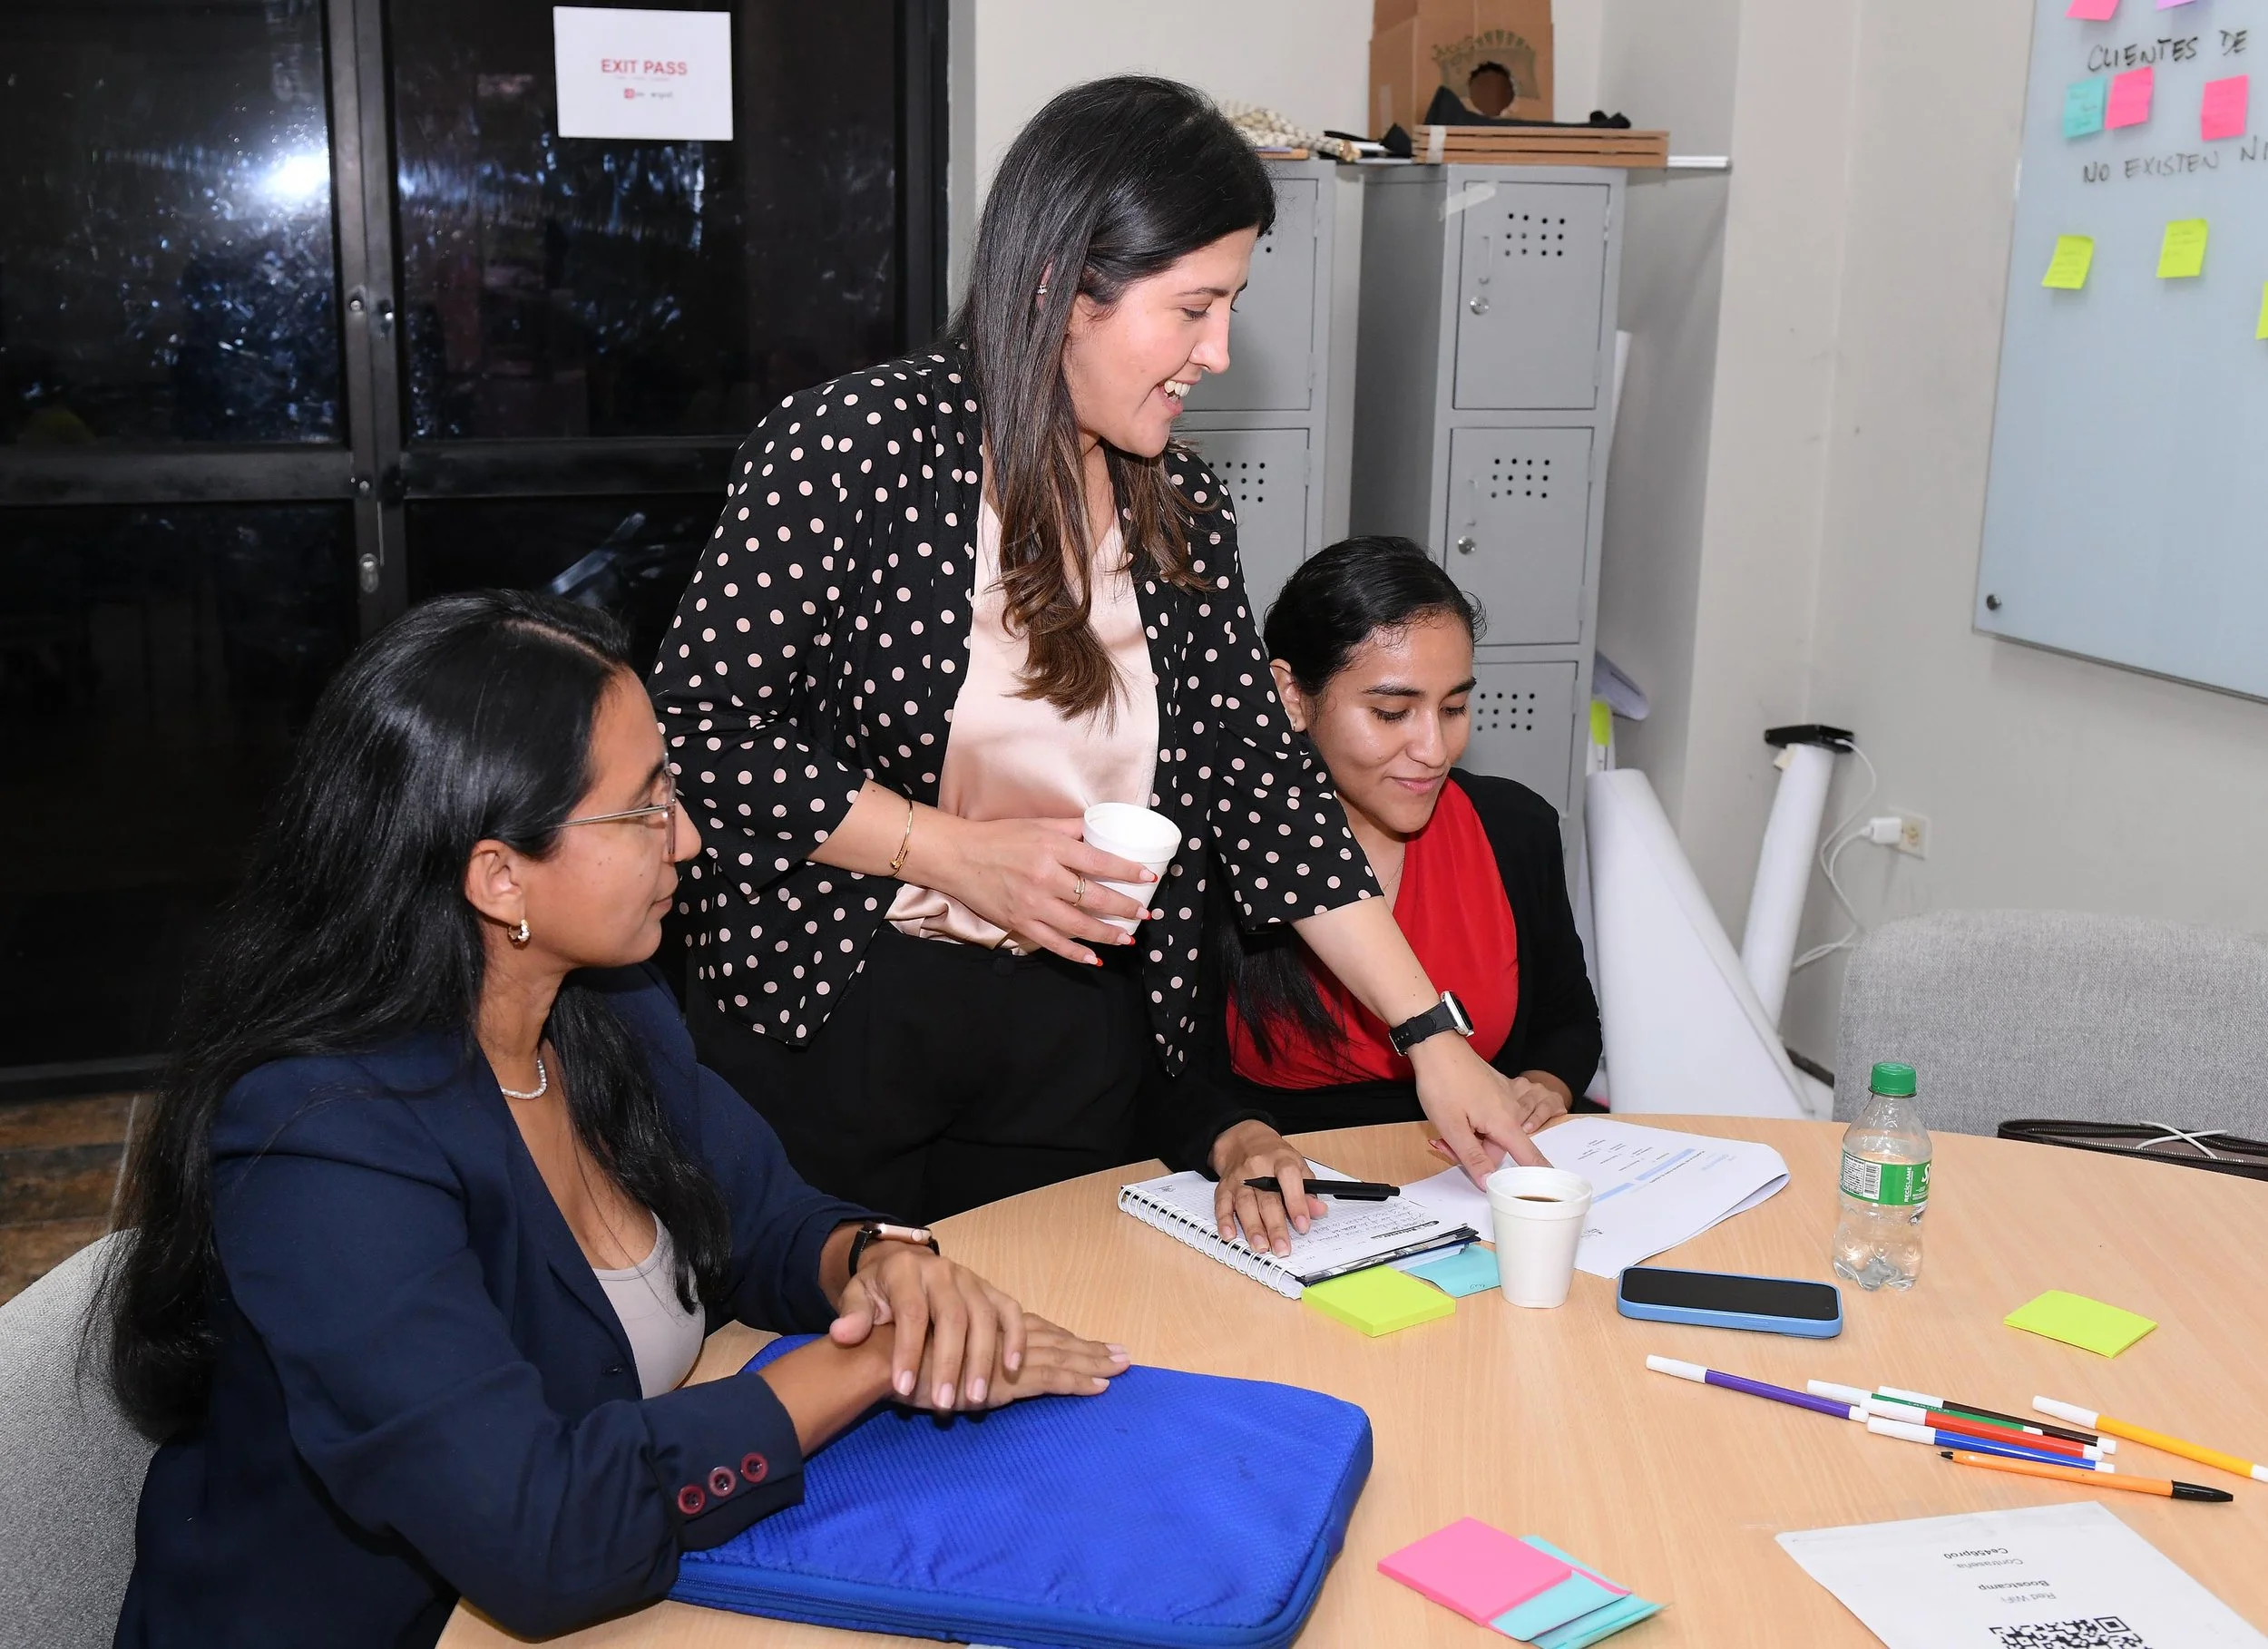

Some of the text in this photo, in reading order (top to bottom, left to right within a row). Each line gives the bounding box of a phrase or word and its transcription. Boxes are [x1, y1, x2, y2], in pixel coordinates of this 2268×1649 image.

[2087, 29, 2247, 72] CLIENTES DE
[601, 58, 688, 75] EXIT PASS
[2083, 161, 2110, 183] NO
[2124, 150, 2220, 180] EXISTEN
[1978, 1580, 2050, 1591] Boostcamp
[2030, 1592, 2057, 1601] Red
